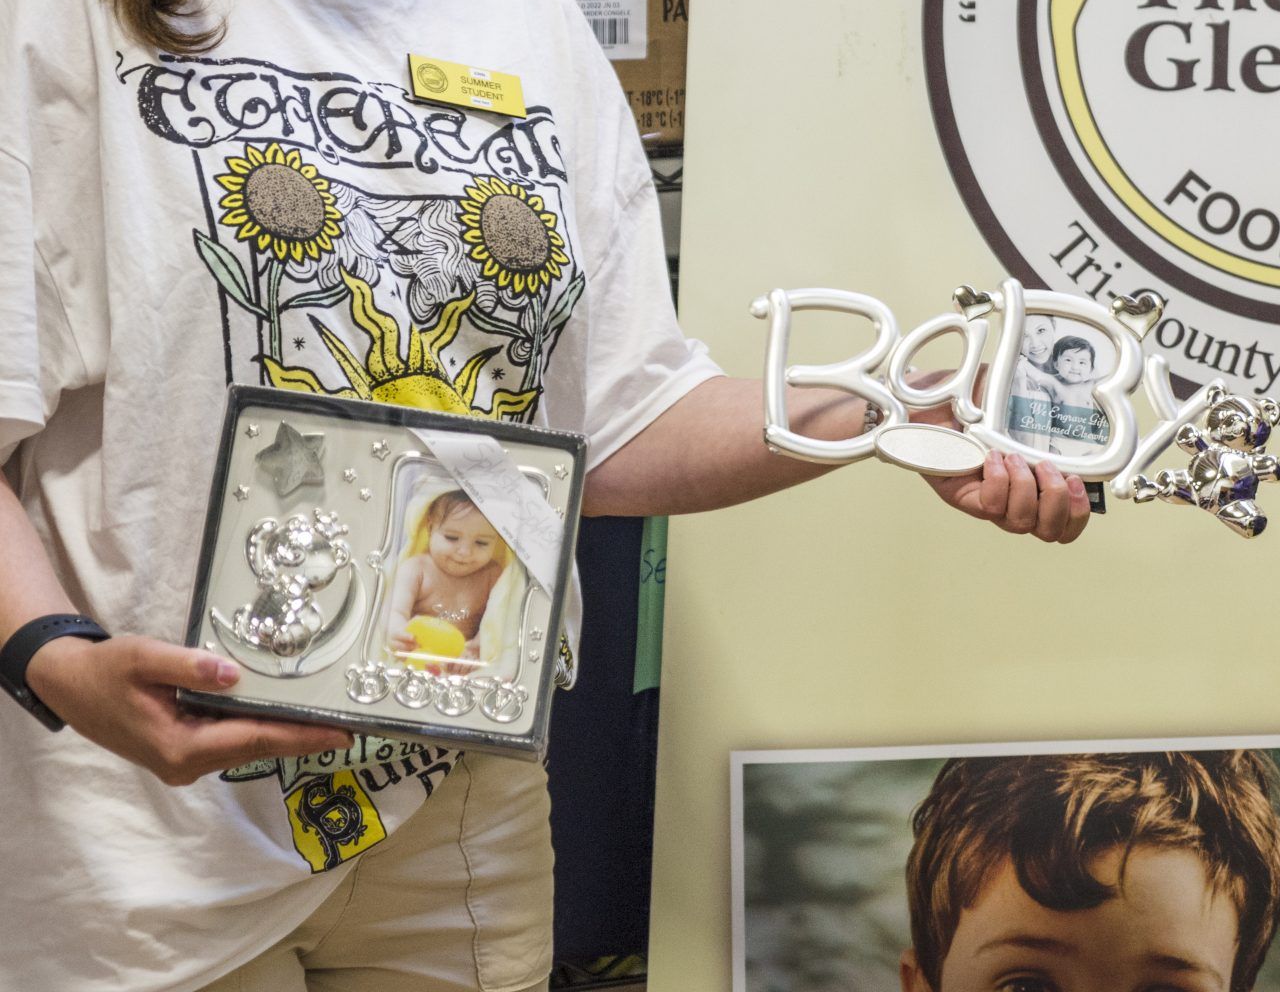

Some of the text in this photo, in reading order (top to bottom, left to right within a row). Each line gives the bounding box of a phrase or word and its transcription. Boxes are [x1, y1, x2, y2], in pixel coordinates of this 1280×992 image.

[460, 75, 503, 91] SUMMER
[461, 86, 504, 101] STUDENT
[1029, 401, 1047, 417] We
[1049, 406, 1087, 423] Engrave
[1020, 415, 1071, 436] Purchased
